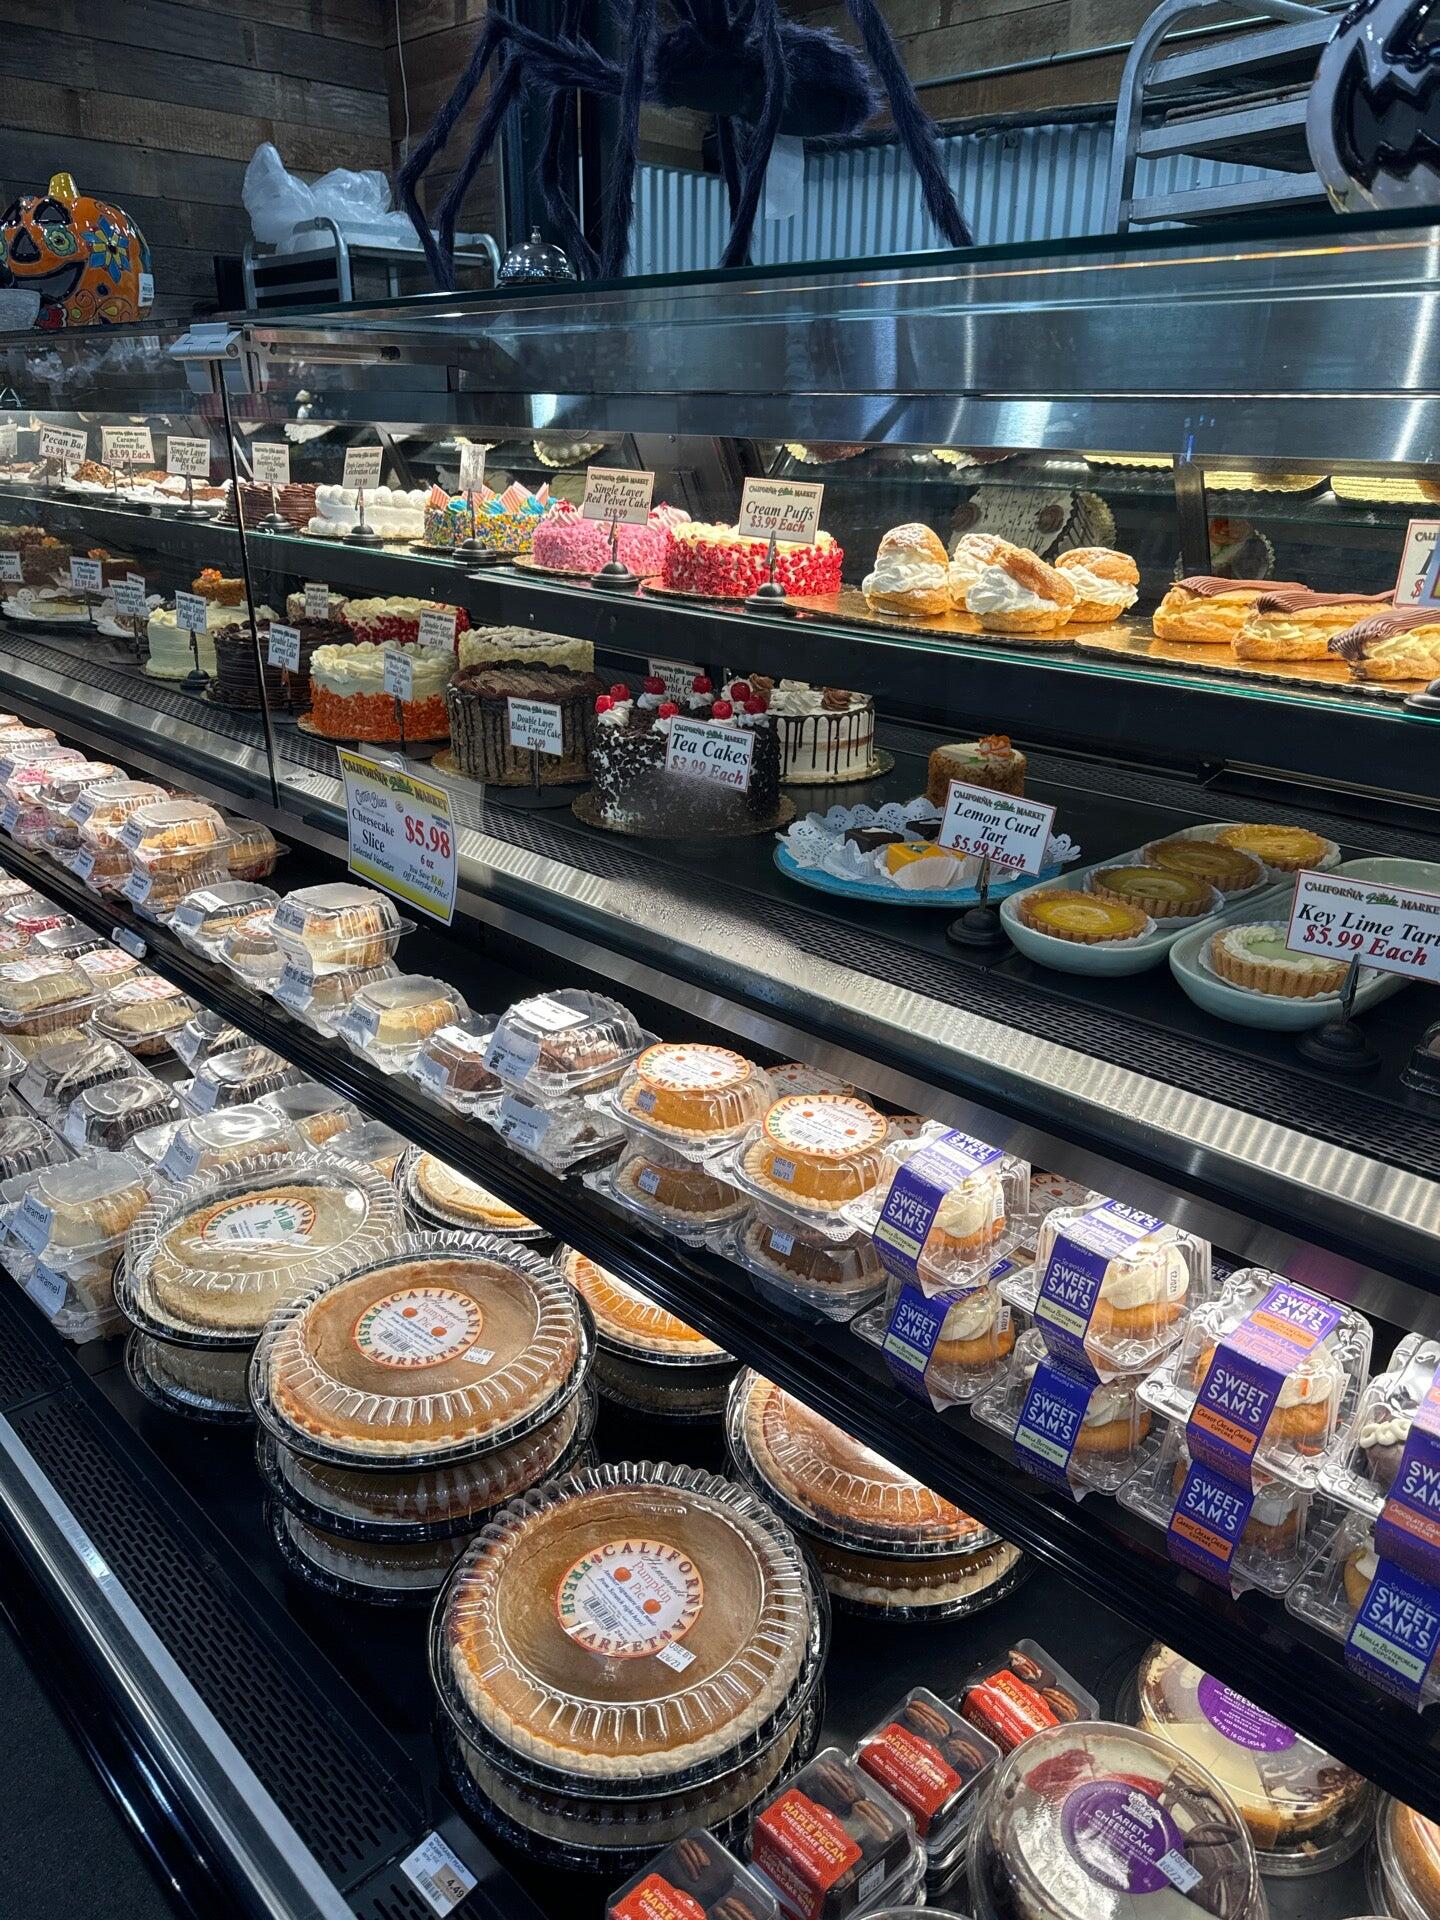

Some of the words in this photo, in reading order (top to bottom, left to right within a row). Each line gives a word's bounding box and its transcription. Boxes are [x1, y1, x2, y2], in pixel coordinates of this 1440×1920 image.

[43, 433, 68, 446] Pecan
[45, 446, 63, 455] $3.99
[65, 450, 81, 459] Each
[110, 449, 129, 458] $3.99
[132, 450, 150, 459] Each
[170, 447, 188, 457] Single
[190, 448, 206, 458] Layer
[171, 456, 189, 465] Fudge
[191, 457, 206, 465] Cake
[585, 493, 602, 503] Red
[604, 493, 627, 506] Velvet
[629, 497, 649, 508] Cake
[593, 482, 618, 497] Single
[620, 486, 644, 497] Layer
[794, 490, 817, 499] MARKET
[746, 501, 781, 517] Cream
[784, 504, 814, 523] Puffs
[750, 515, 777, 529] $3.99
[778, 519, 805, 533] Each
[511, 721, 526, 732] Black
[528, 725, 545, 735] Forest
[547, 729, 561, 739] Cake
[517, 714, 537, 725] Double
[538, 718, 554, 729] Layer
[671, 732, 698, 754] Tea
[702, 740, 750, 766] Cakes
[724, 734, 748, 746] MARKET
[342, 758, 389, 787] CALIFORNIA
[414, 786, 448, 813] MARKET
[708, 764, 744, 785] Each
[953, 790, 994, 807] CALIFORNIA
[1016, 806, 1046, 822] MARKET
[954, 802, 1001, 827] Lemon
[1004, 816, 1041, 838] Curd
[352, 807, 395, 837] Cheesecake
[980, 825, 1007, 845] Tart
[362, 829, 385, 853] Slice
[405, 815, 451, 859] $5.98
[951, 834, 989, 855] $5.99
[990, 842, 1026, 869] Each
[352, 843, 373, 860] Selected
[373, 854, 394, 872] Varieties
[409, 864, 418, 873] You
[419, 869, 430, 880] Save
[421, 855, 425, 865] 6
[426, 859, 434, 869] oz
[402, 871, 412, 882] Off
[411, 874, 433, 894] Everyday
[1304, 881, 1364, 901] CALIFORNIA
[1400, 900, 1440, 915] MARKE
[1298, 902, 1336, 928] Key
[1341, 912, 1394, 937] Lime
[1400, 923, 1440, 947] Tart
[1303, 924, 1364, 951] $5.99
[1367, 937, 1428, 966] Each
[350, 1005, 373, 1028] Caramel
[788, 1096, 884, 1139] CALIFORNIA
[786, 1141, 862, 1155] MARKET
[949, 1135, 990, 1161] SAM'S
[775, 1157, 786, 1166] USE
[787, 1162, 796, 1170] BY
[24, 1201, 48, 1224] Caramel
[887, 1204, 926, 1235] SAM'S
[893, 1191, 931, 1221] SWEET
[1111, 1202, 1158, 1228] SAM'S
[36, 1268, 61, 1295] Caramel
[1052, 1263, 1096, 1291] SWEET
[1047, 1277, 1091, 1309] SAM'S
[1276, 1293, 1329, 1322] SWEET
[359, 1308, 382, 1346] FRESH
[390, 1289, 480, 1345] CALIFORNIA
[416, 1316, 433, 1329] Pie
[417, 1302, 455, 1329] Pumpkin
[900, 1304, 937, 1333] SWEET
[1041, 1300, 1056, 1315] VANILLA
[1055, 1308, 1082, 1329] BUTTERCREAM
[1268, 1301, 1322, 1331] SAM'S
[895, 1317, 932, 1347] SAM'S
[370, 1349, 447, 1365] MARKET
[1214, 1369, 1268, 1406] SWEET
[1032, 1392, 1077, 1425] SWEET
[1208, 1383, 1262, 1423] SAM'S
[1028, 1406, 1072, 1440] SAM'S
[1197, 1408, 1216, 1423] CARROT
[1216, 1419, 1234, 1433] CREAM
[1234, 1428, 1252, 1444] CHEESE
[1211, 1424, 1234, 1440] CUPCAKE
[1190, 1478, 1243, 1514] SWEET
[1185, 1493, 1237, 1531] SAM'S
[1389, 1503, 1425, 1528] CHOCOLATE
[1176, 1517, 1195, 1531] CARROT
[1194, 1527, 1211, 1540] CREAM
[1211, 1536, 1228, 1551] CHEESE
[1406, 1521, 1433, 1539] CUPCAKE
[562, 1561, 593, 1615] FRESH
[602, 1542, 701, 1630] CALIFORNIA
[630, 1582, 645, 1599] Pie
[633, 1560, 672, 1603] Pumpkin
[1390, 1582, 1399, 1592] So
[1399, 1590, 1423, 1606] worth
[1376, 1587, 1438, 1632] SWEET
[1369, 1603, 1431, 1650] SAM'S
[668, 1643, 683, 1656] USE
[682, 1651, 694, 1661] BY
[1359, 1630, 1380, 1648] VANILLA
[1379, 1642, 1419, 1670] BUTTERCREAM
[1372, 1647, 1399, 1665] CUPCAKE
[996, 1679, 1024, 1707] MAPLE
[885, 1733, 917, 1761] MAPLE
[884, 1742, 921, 1776] CHEESECAKE
[921, 1773, 938, 1791] BITES
[780, 1812, 819, 1848] CHEESECAKE
[817, 1845, 837, 1864] BITES
[782, 1801, 816, 1835] MAPLE
[814, 1831, 847, 1863] PECAN
[794, 1802, 824, 1830] CHOCOLATE
[823, 1828, 847, 1851] COVERED
[1094, 1809, 1155, 1855] CHEESECAKE
[1112, 1809, 1150, 1840] VARIETY
[1169, 1851, 1189, 1869] USE
[1186, 1865, 1201, 1880] BY
[447, 1879, 464, 1898] 4.49
[640, 1889, 675, 1920] MAPLE
